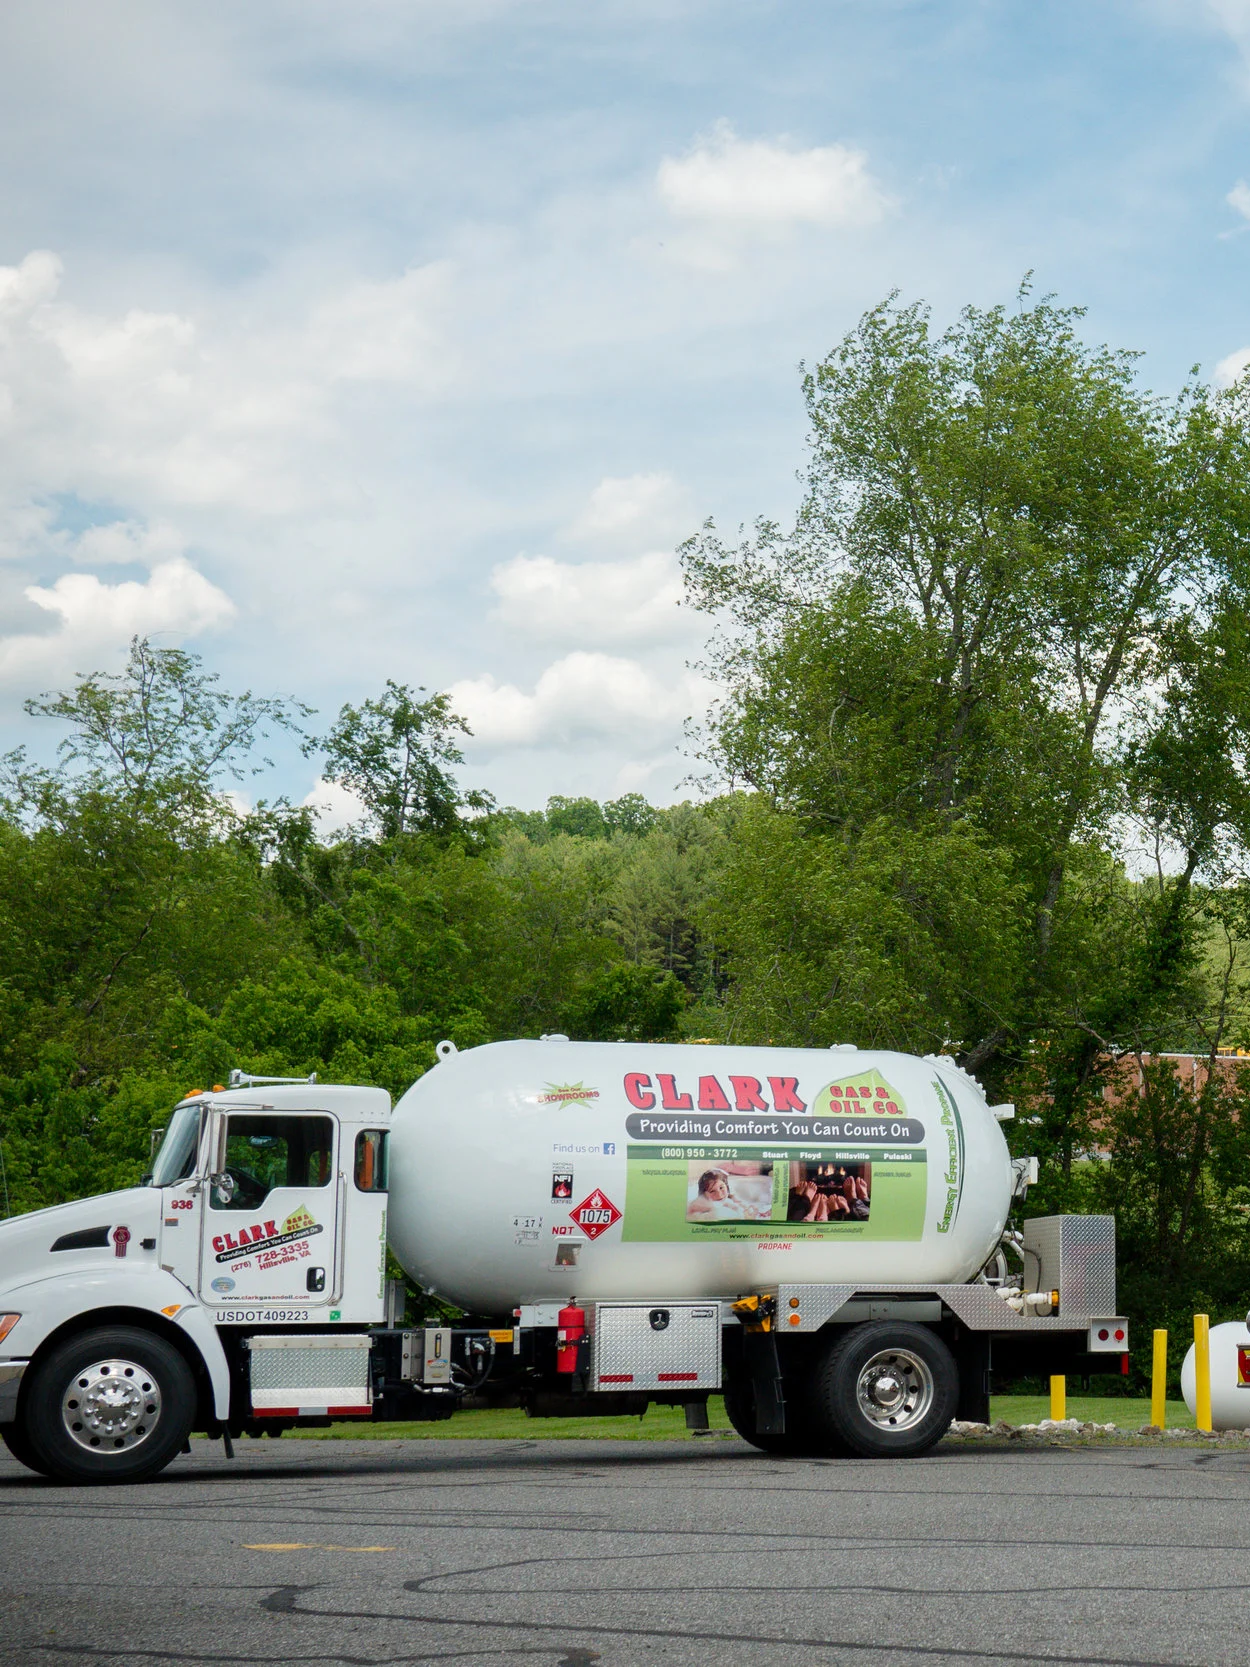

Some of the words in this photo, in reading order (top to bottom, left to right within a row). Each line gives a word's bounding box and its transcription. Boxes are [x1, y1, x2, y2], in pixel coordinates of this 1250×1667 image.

[623, 1072, 808, 1114] CLARK
[829, 1086, 872, 1098] GAS
[875, 1087, 889, 1099] &
[829, 1100, 866, 1114] OIL
[873, 1101, 903, 1115] CO.
[640, 1119, 711, 1137] Providing
[715, 1120, 779, 1135] Comfort
[782, 1121, 809, 1135] You
[813, 1122, 840, 1136] Can
[844, 1122, 887, 1136] Count
[891, 1123, 910, 1137] On
[553, 1143, 573, 1153] Find
[576, 1145, 586, 1153] us
[661, 1148, 684, 1159] (800)
[687, 1148, 705, 1158] 950
[714, 1148, 738, 1158] 3772
[799, 1152, 822, 1160] Floyd
[835, 1152, 870, 1160] Hillsville
[581, 1209, 610, 1223] 1075
[212, 1220, 279, 1253] CLARK
[552, 1226, 575, 1235] NOT
[591, 1227, 597, 1235] 2
[219, 1249, 247, 1261] Providing
[246, 1241, 270, 1254] Comfort
[270, 1238, 281, 1246] You
[281, 1234, 292, 1242] Can
[293, 1230, 310, 1238] Count
[255, 1240, 309, 1263] 728-3335
[259, 1256, 298, 1271] Hillsville,
[299, 1250, 311, 1258] VA
[216, 1310, 309, 1321] USDOT409223
